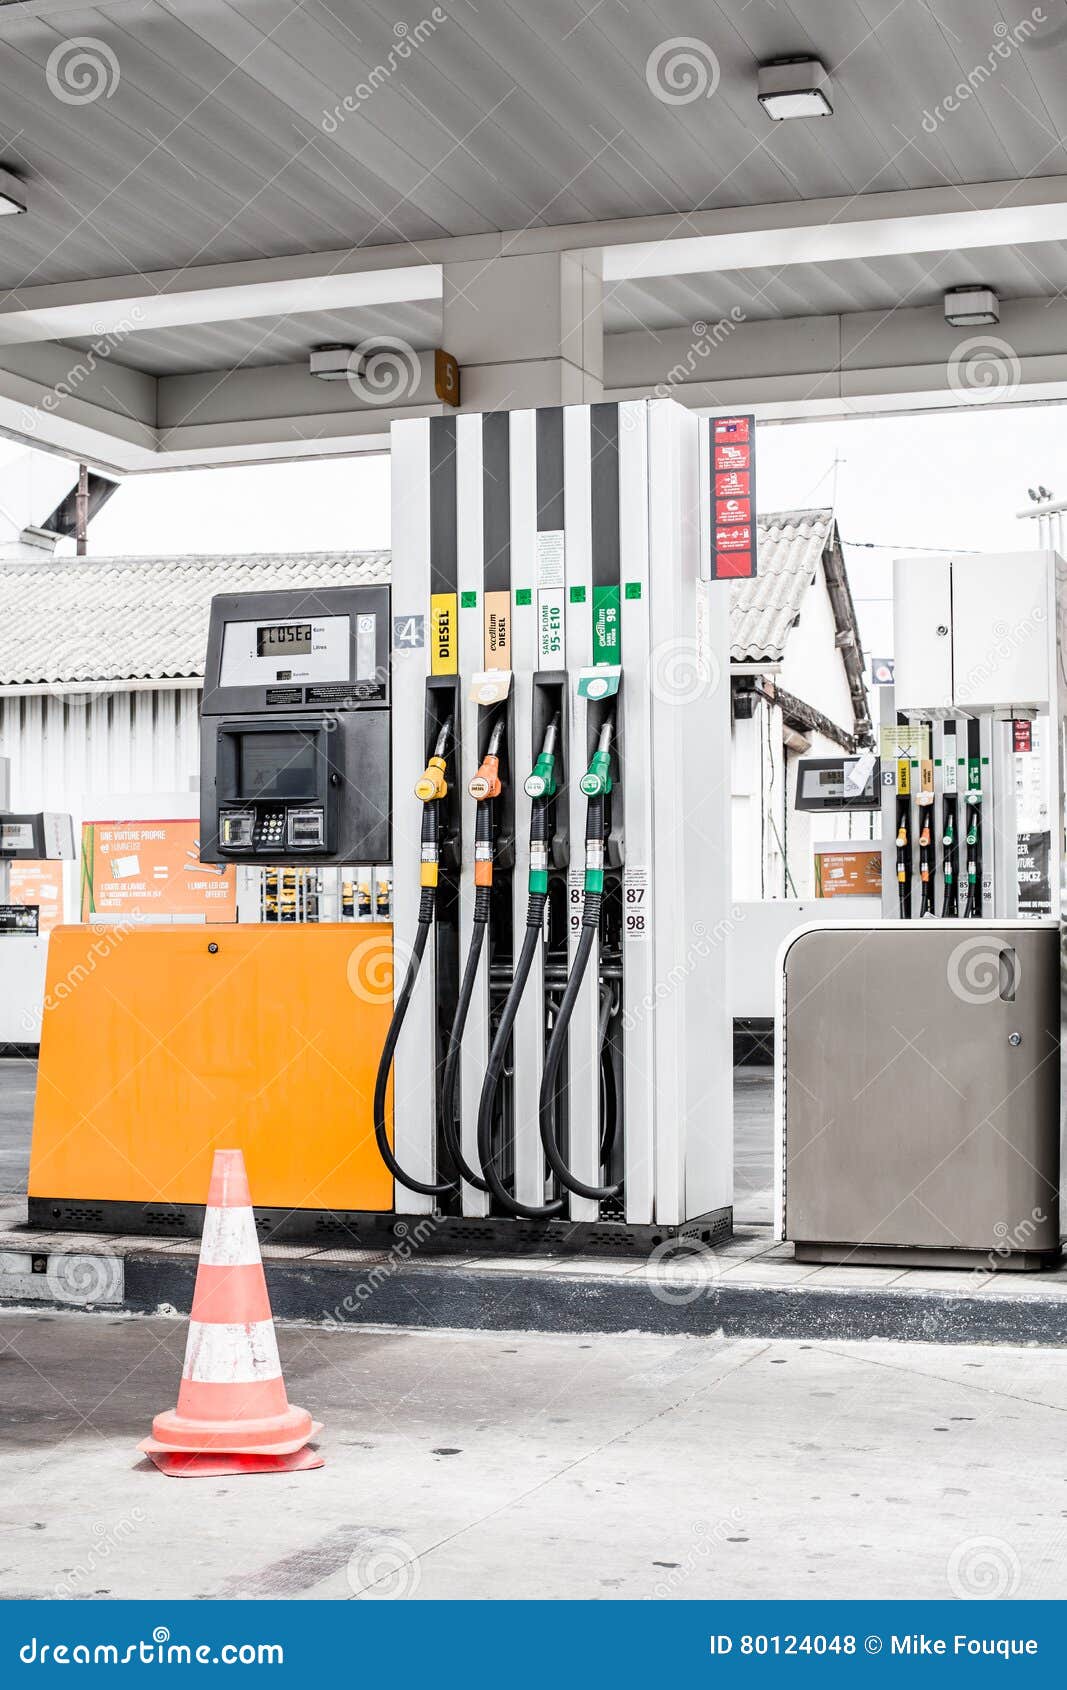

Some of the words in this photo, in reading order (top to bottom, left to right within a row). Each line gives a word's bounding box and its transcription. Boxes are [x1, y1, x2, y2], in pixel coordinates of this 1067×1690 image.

[446, 363, 453, 390] 5
[606, 608, 617, 623] 98
[400, 618, 419, 646] 4
[439, 610, 450, 658] DIESEL
[489, 613, 497, 652] excellium
[498, 617, 506, 647] DIESEL
[550, 607, 561, 651] 95-E10
[884, 772, 894, 785] 8
[141, 829, 167, 841] PROPRE
[960, 881, 968, 889] 85
[983, 881, 992, 889] 87
[626, 888, 645, 903] 87
[983, 892, 992, 900] 98
[626, 915, 645, 930] 98
